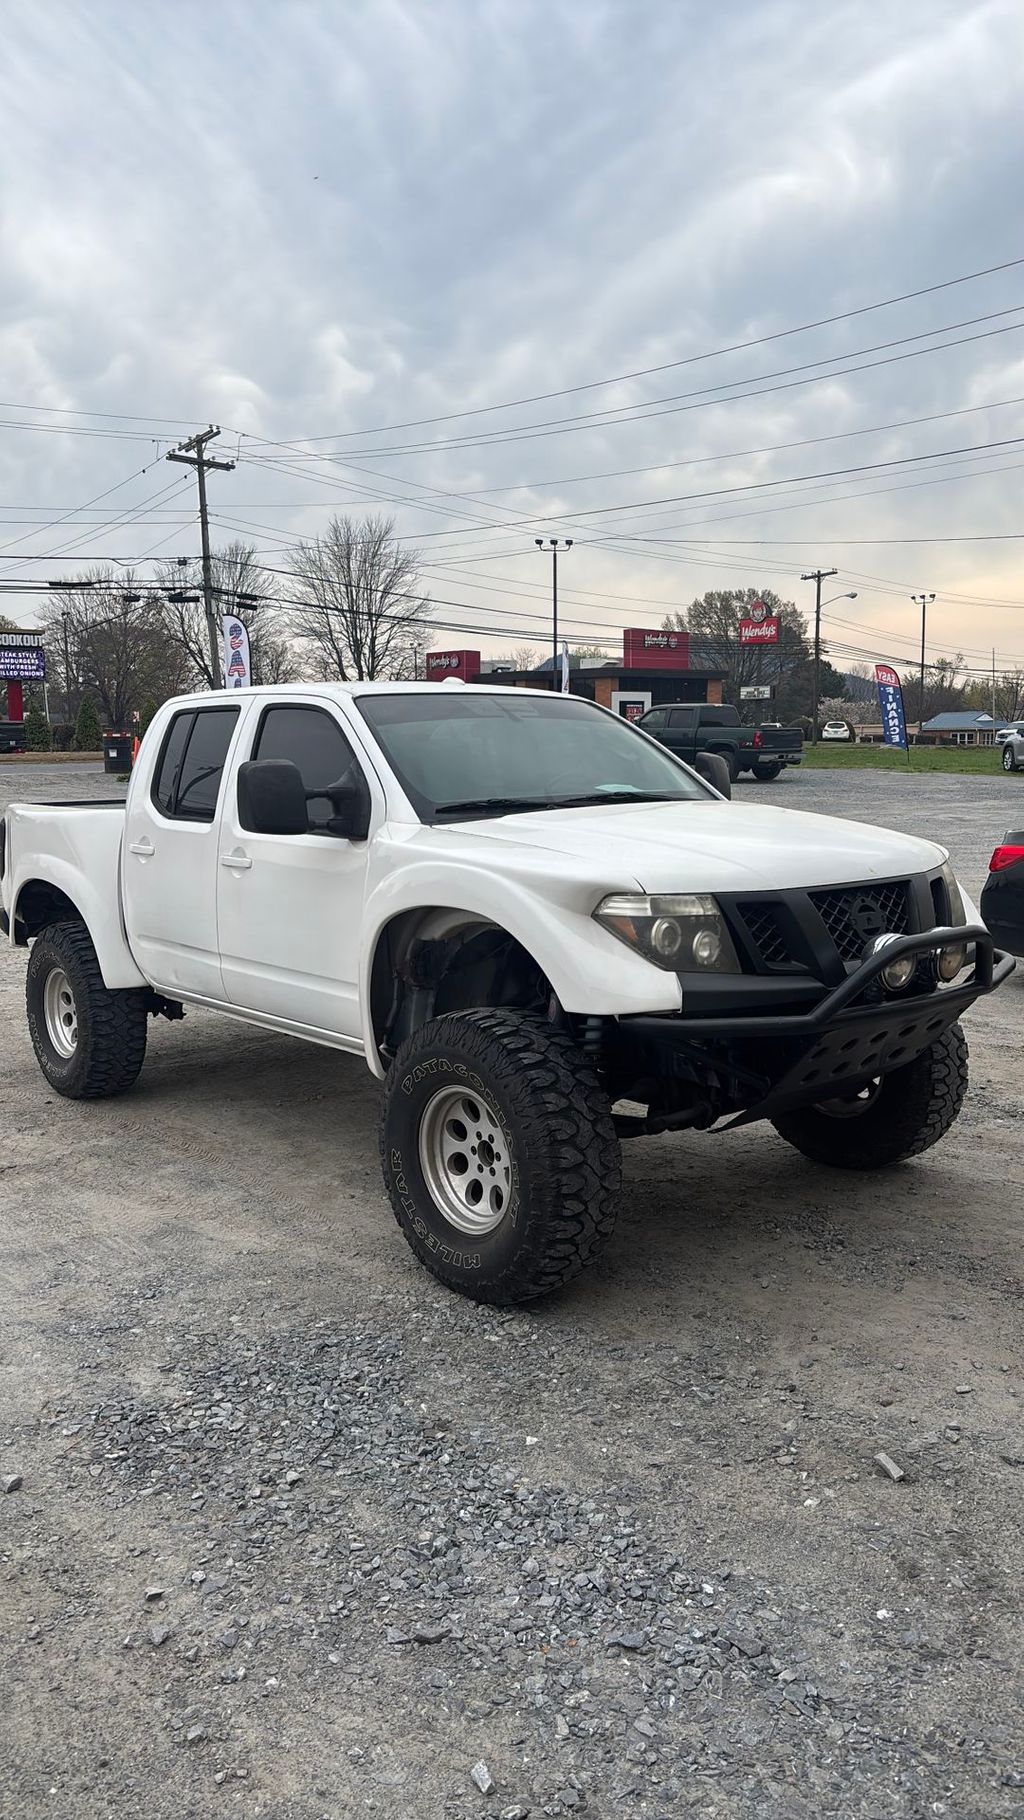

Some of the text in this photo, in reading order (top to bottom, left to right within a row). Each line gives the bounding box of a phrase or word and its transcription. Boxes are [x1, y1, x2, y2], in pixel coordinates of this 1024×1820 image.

[0, 634, 43, 646] OOKOUT
[741, 622, 776, 641] Wendy's
[391, 1148, 481, 1269] MILESTAR
